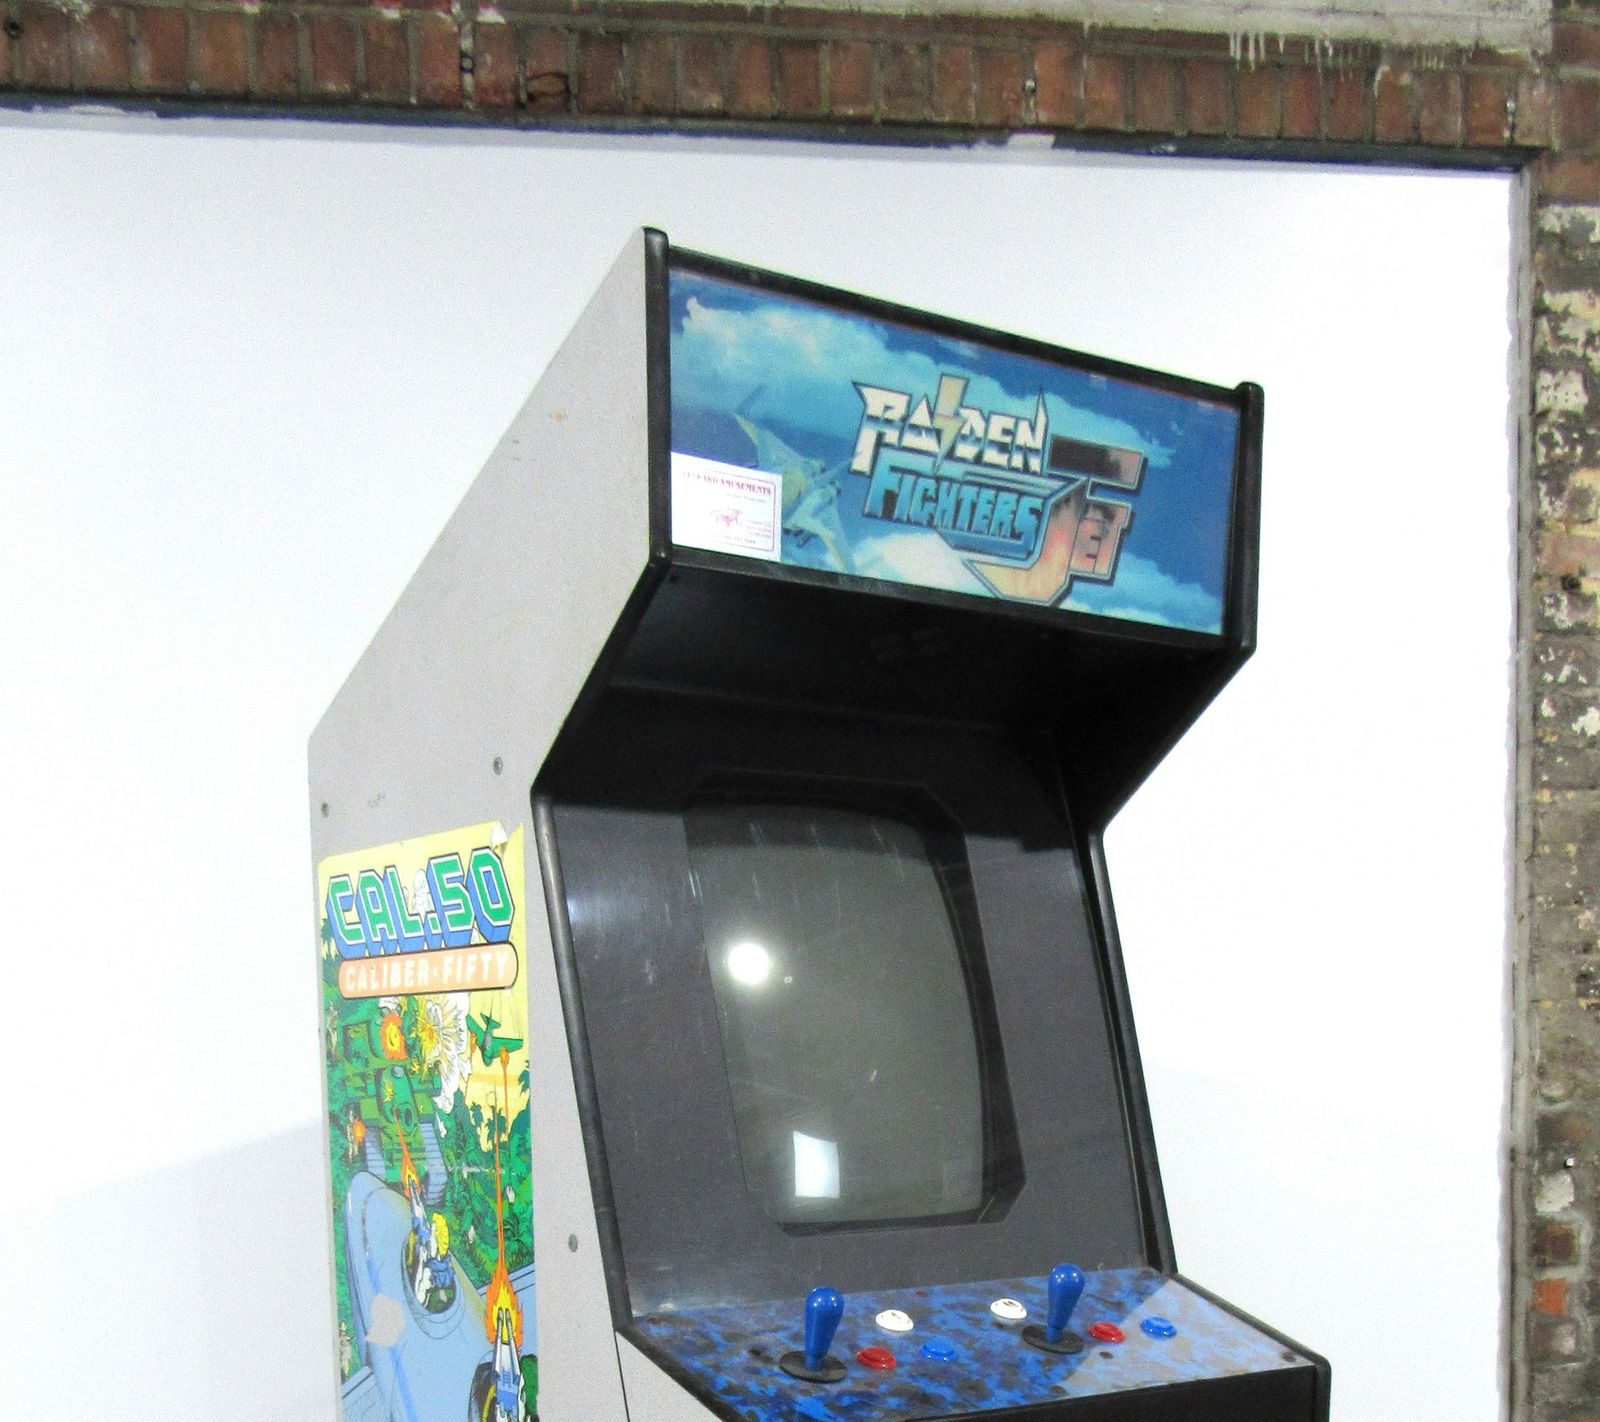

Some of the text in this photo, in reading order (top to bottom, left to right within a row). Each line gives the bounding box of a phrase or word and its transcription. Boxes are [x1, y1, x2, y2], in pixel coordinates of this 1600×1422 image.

[850, 373, 1049, 477] RAIDEN
[720, 479, 773, 497] AMUSEMENTS
[863, 463, 1045, 543] FIGHTERS
